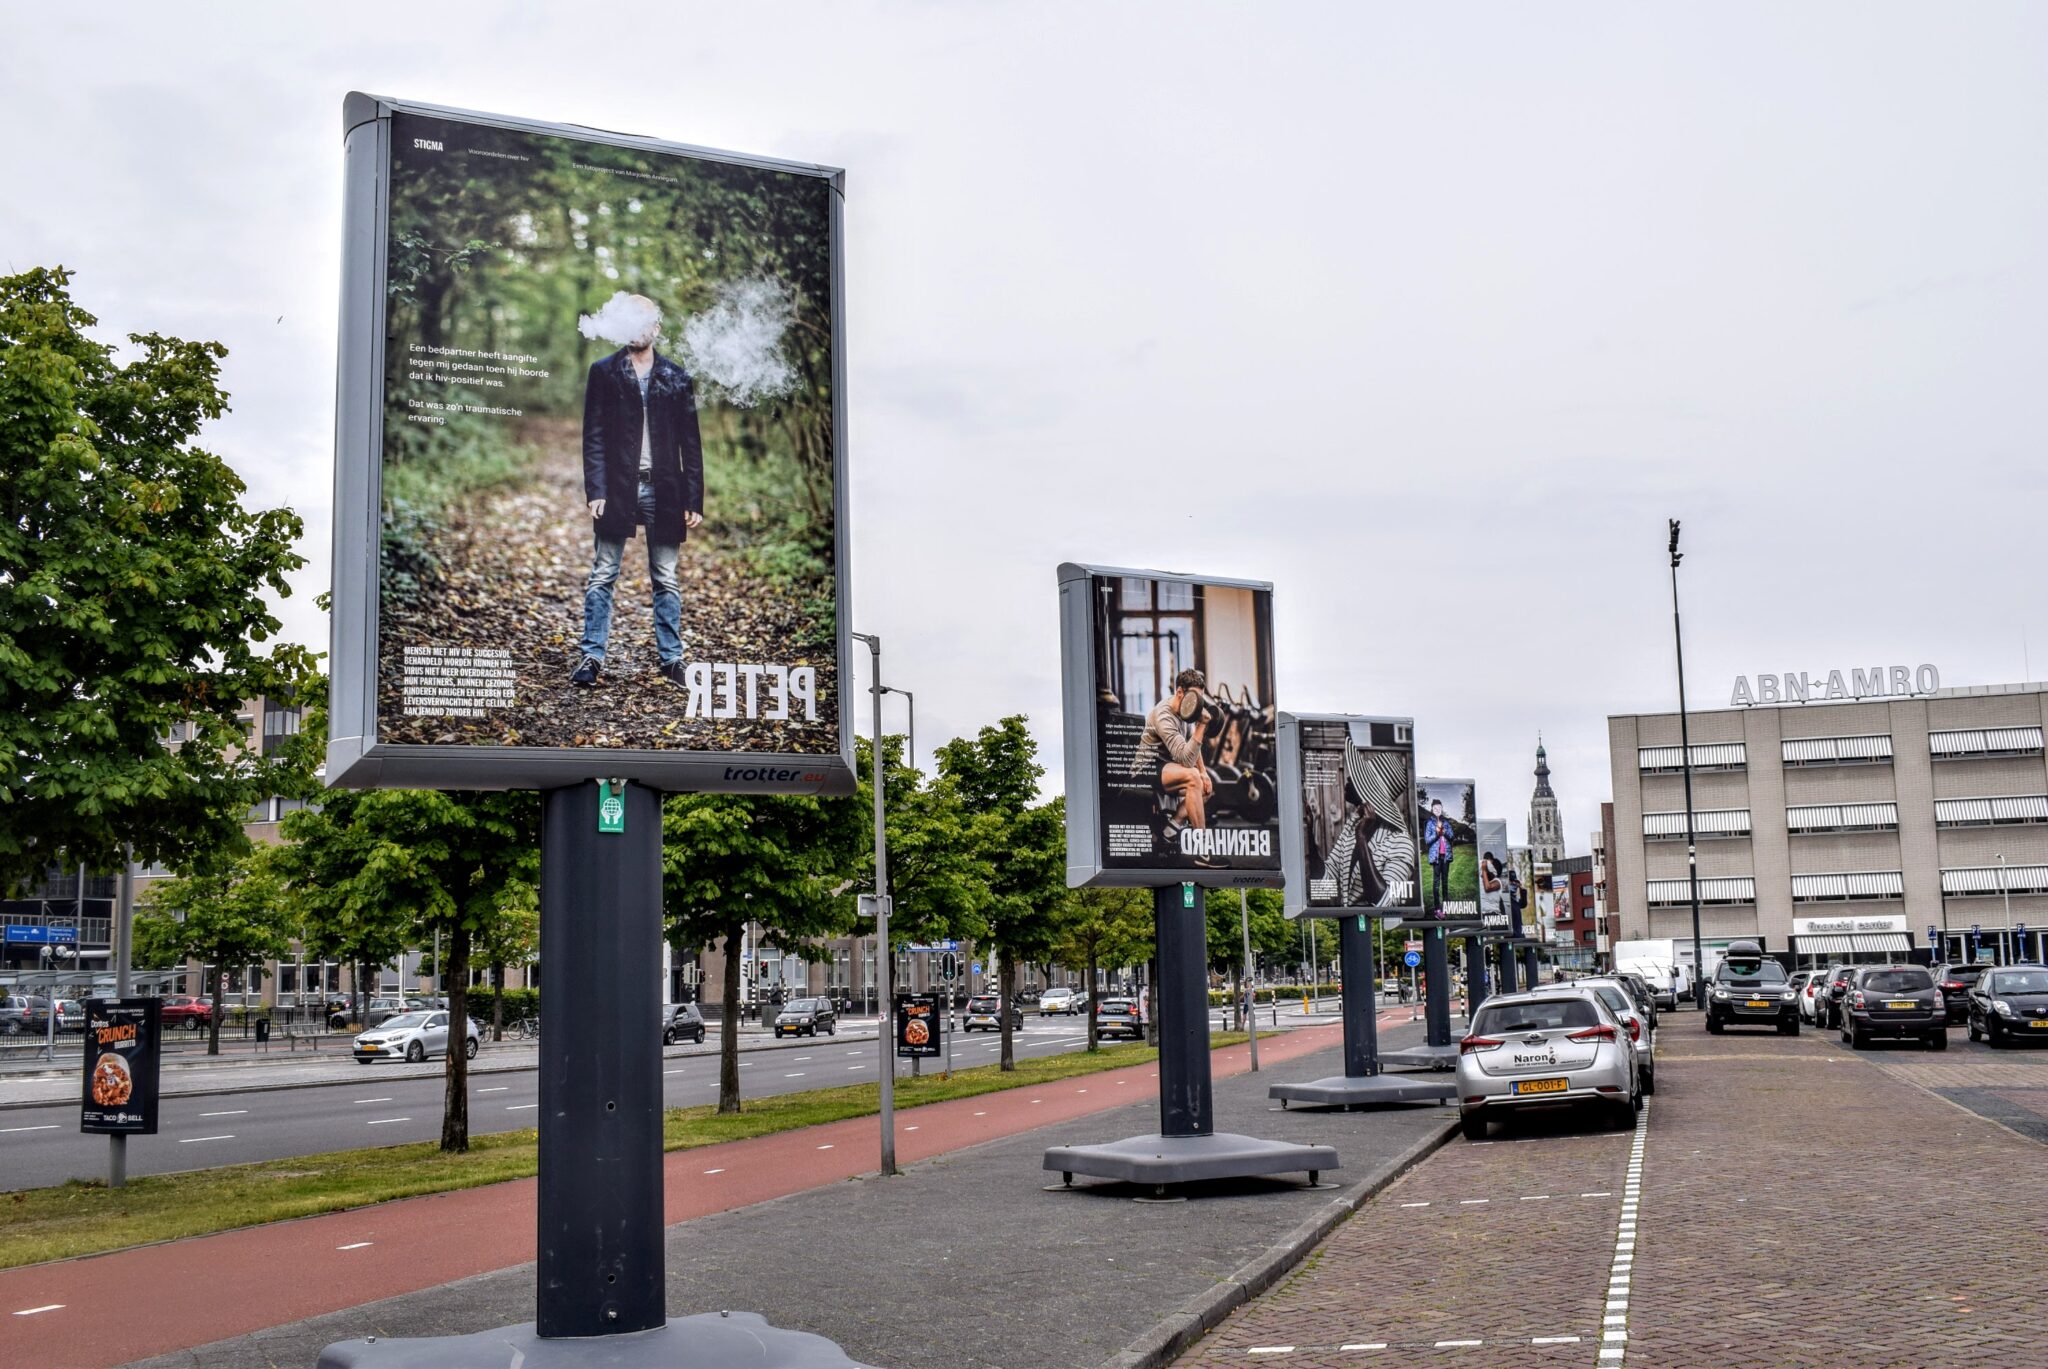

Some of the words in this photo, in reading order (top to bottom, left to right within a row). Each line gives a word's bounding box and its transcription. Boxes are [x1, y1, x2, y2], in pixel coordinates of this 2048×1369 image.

[414, 139, 443, 151] STIGMA
[410, 344, 426, 352] Een
[428, 345, 476, 358] bedpartner
[478, 350, 500, 360] heeft
[502, 353, 538, 363] aangifte
[410, 358, 434, 367] tegen
[436, 361, 450, 370] mij
[452, 362, 483, 372] gedaan
[486, 366, 505, 374] toen
[507, 366, 517, 376] hij
[519, 368, 549, 378] hoorde
[409, 371, 424, 380] dat
[426, 372, 432, 381] ik
[436, 374, 483, 385] hiv-positief
[486, 380, 505, 388] was.
[409, 399, 424, 408] Dat
[426, 401, 444, 410] was
[446, 402, 463, 412] zo'n
[466, 404, 522, 416] traumatische
[408, 415, 446, 425] ervaring.
[404, 646, 431, 655] MENSEN
[433, 647, 447, 656] MET
[449, 648, 460, 656] HIV
[462, 648, 472, 657] DIE
[474, 649, 511, 658] SUCCESVOL
[404, 657, 442, 666] BEHANDELD
[444, 658, 471, 667] WORDEN
[473, 659, 499, 668] KUNNEN
[500, 660, 513, 668] HET
[404, 667, 423, 675] VIRUS
[425, 667, 439, 676] NIET
[441, 668, 459, 676] MEER
[460, 668, 502, 678] OVERDRAGEN
[503, 670, 516, 678] AAN
[404, 677, 418, 685] HUN
[420, 677, 456, 687] PARTNERS,
[457, 678, 483, 687] KUNNEN
[485, 679, 514, 688] GEZONDE
[1730, 672, 1809, 706] ABN
[1825, 664, 1939, 700] AMRO
[404, 687, 437, 696] KINDEREN
[439, 688, 465, 696] KRIJGEN
[467, 688, 475, 696] EN
[476, 689, 501, 697] HEBBEN
[502, 690, 515, 698] EEN
[404, 697, 472, 707] LEVENSVERWACHTING
[474, 698, 484, 707] DIE
[486, 699, 507, 708] GELIJK
[508, 699, 514, 708] IS
[404, 707, 417, 715] AAN
[419, 707, 444, 716] IEMAND
[446, 708, 471, 716] ZONDER
[472, 708, 485, 717] HIV.
[1807, 920, 1854, 932] financial
[1857, 920, 1893, 930] center
[99, 1024, 136, 1044] CRUNCH
[114, 1040, 136, 1049] BURRITO
[1514, 1054, 1548, 1063] Naron
[1523, 1080, 1562, 1091] GL-001-F
